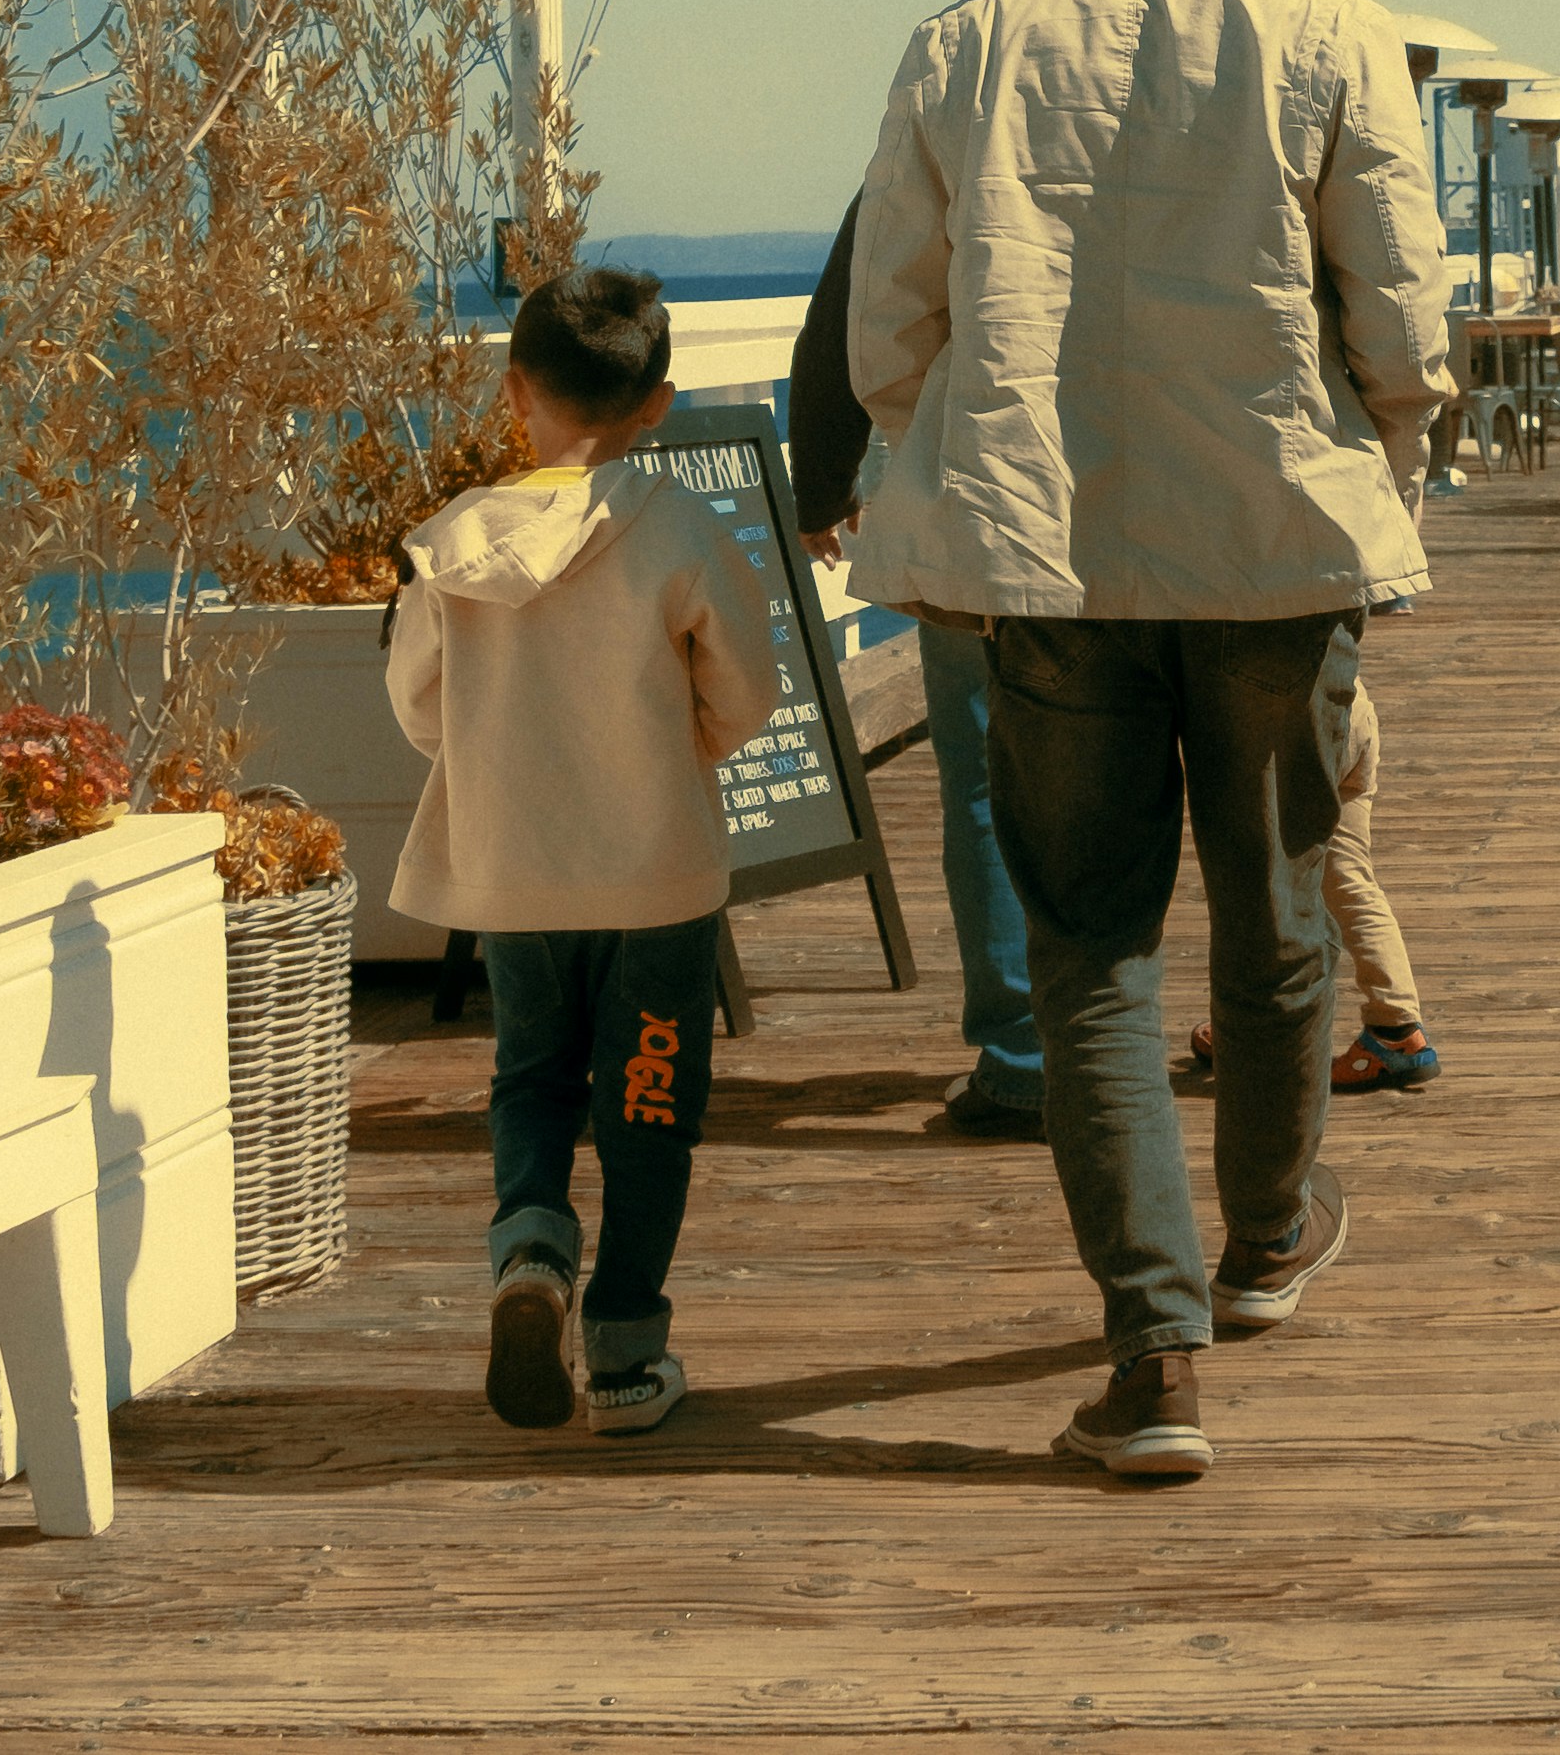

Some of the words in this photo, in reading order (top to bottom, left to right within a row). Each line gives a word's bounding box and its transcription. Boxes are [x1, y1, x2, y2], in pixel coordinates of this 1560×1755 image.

[669, 445, 761, 493] RESERVED
[777, 731, 807, 752] SPACE
[799, 751, 820, 770] CAN
[731, 786, 766, 809] SEATED
